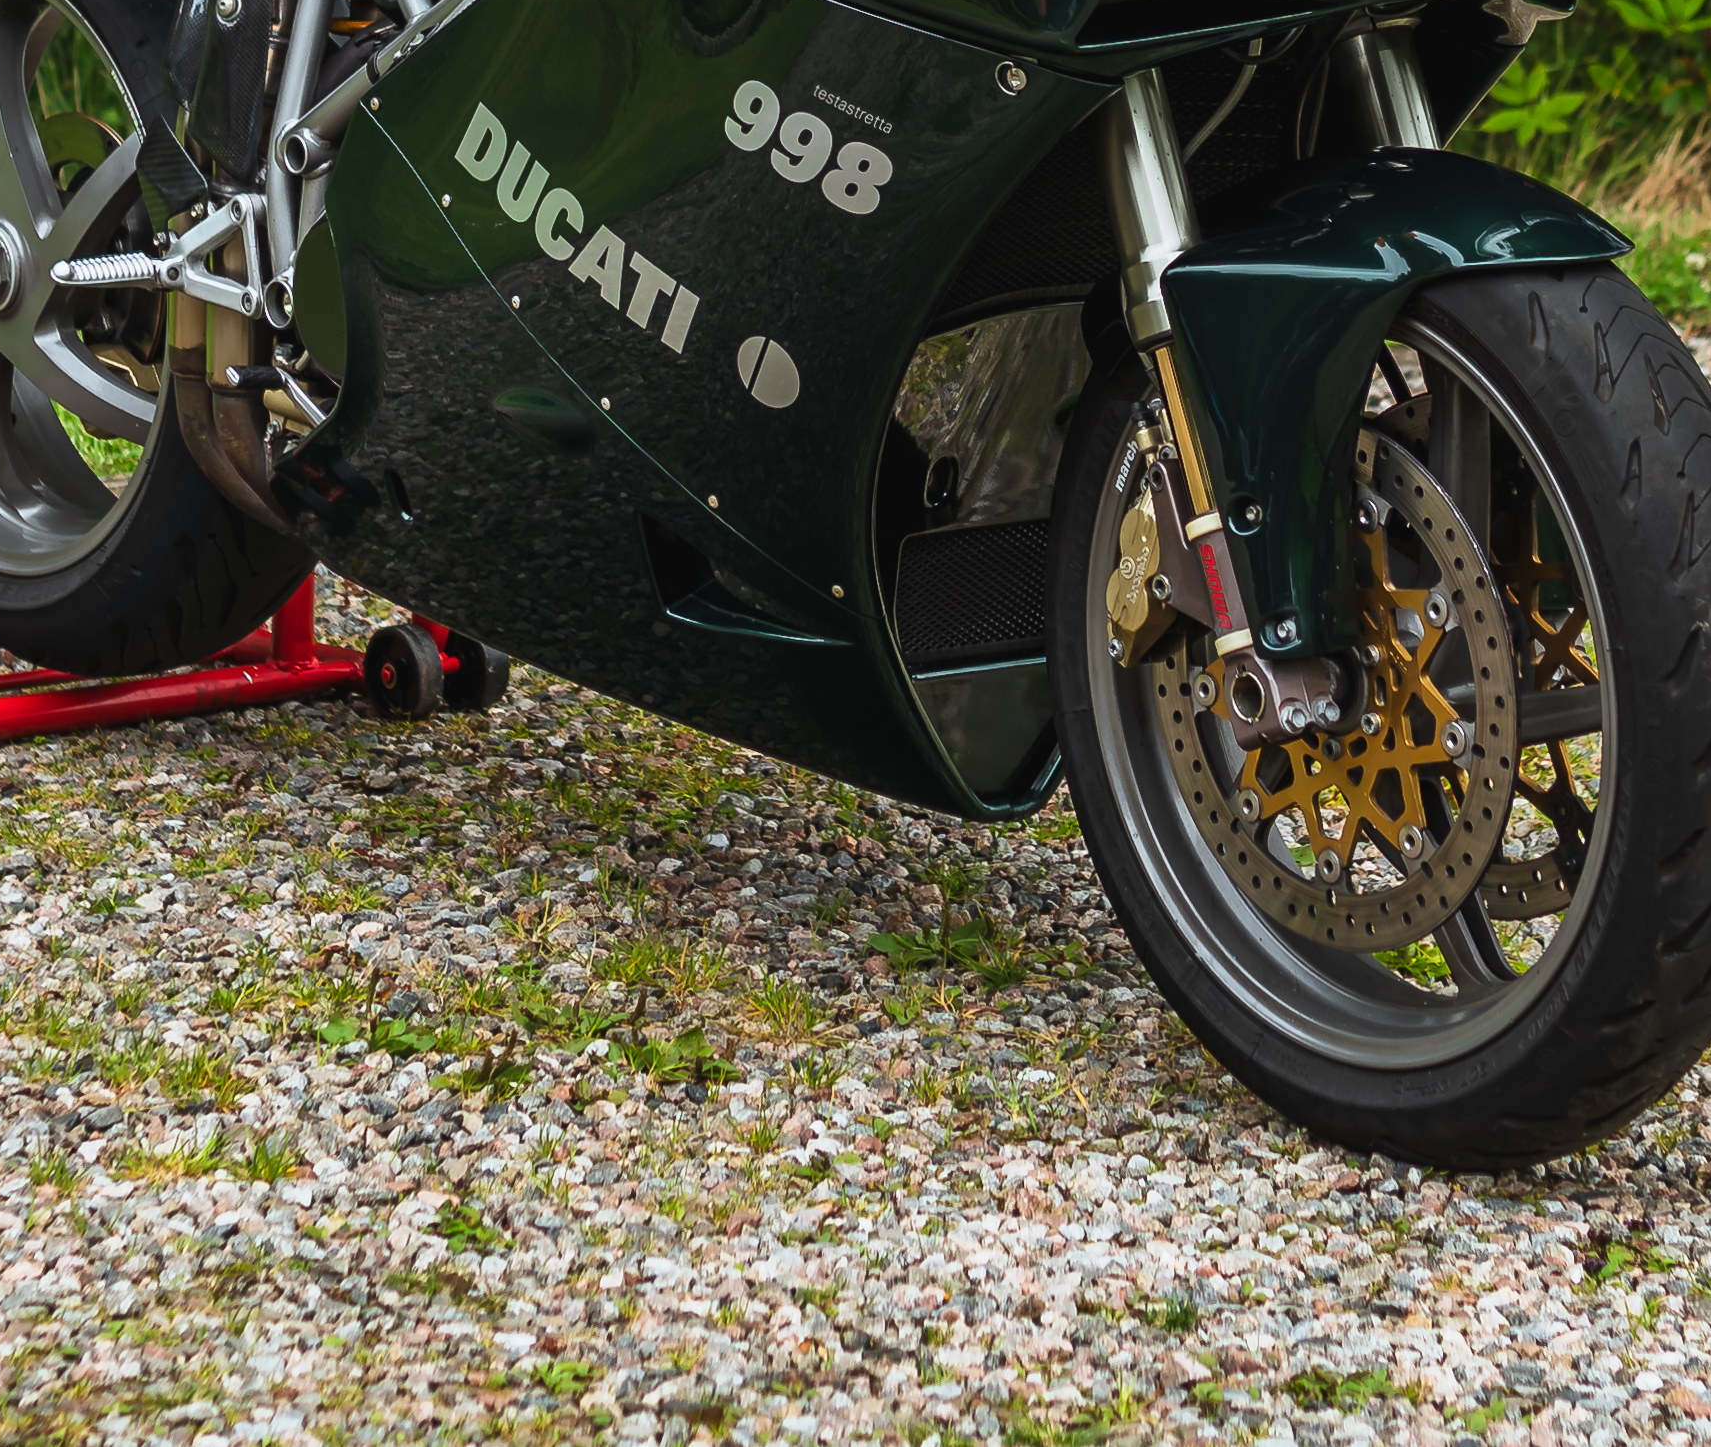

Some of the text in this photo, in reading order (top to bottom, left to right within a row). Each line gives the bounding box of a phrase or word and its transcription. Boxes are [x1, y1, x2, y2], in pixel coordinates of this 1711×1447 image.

[724, 79, 894, 215] 998
[813, 84, 893, 134] testastretta
[454, 102, 700, 354] DUCATI
[1198, 543, 1233, 630] SHOWA
[1527, 994, 1562, 1041] ROAD
